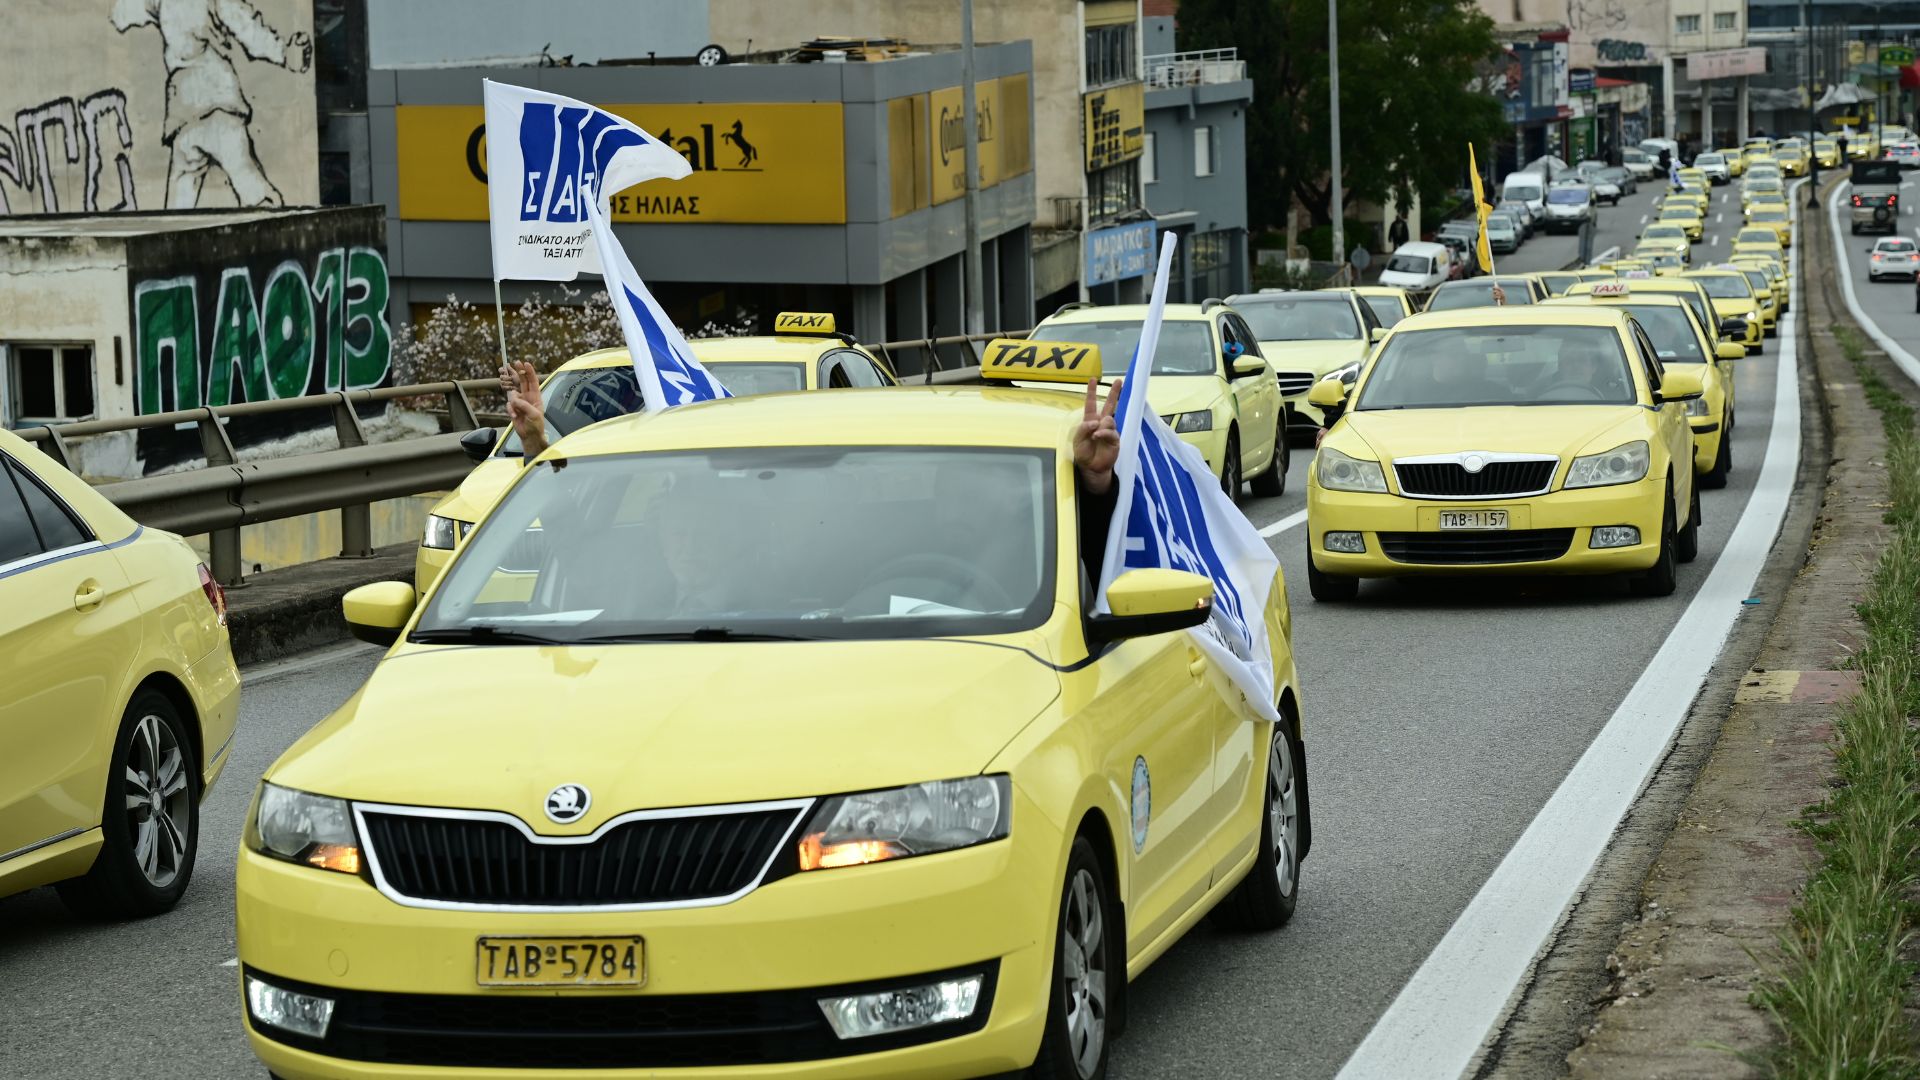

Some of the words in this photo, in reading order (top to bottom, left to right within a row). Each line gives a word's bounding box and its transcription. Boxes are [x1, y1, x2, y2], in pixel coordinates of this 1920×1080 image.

[636, 196, 699, 215] ΗΛΙΑΣ
[543, 248, 563, 258] ΤΑΞΙ
[1594, 284, 1625, 293] TAXI
[779, 314, 827, 327] TAXI
[991, 344, 1090, 370] TAXI
[484, 944, 637, 979] TAB-5784
